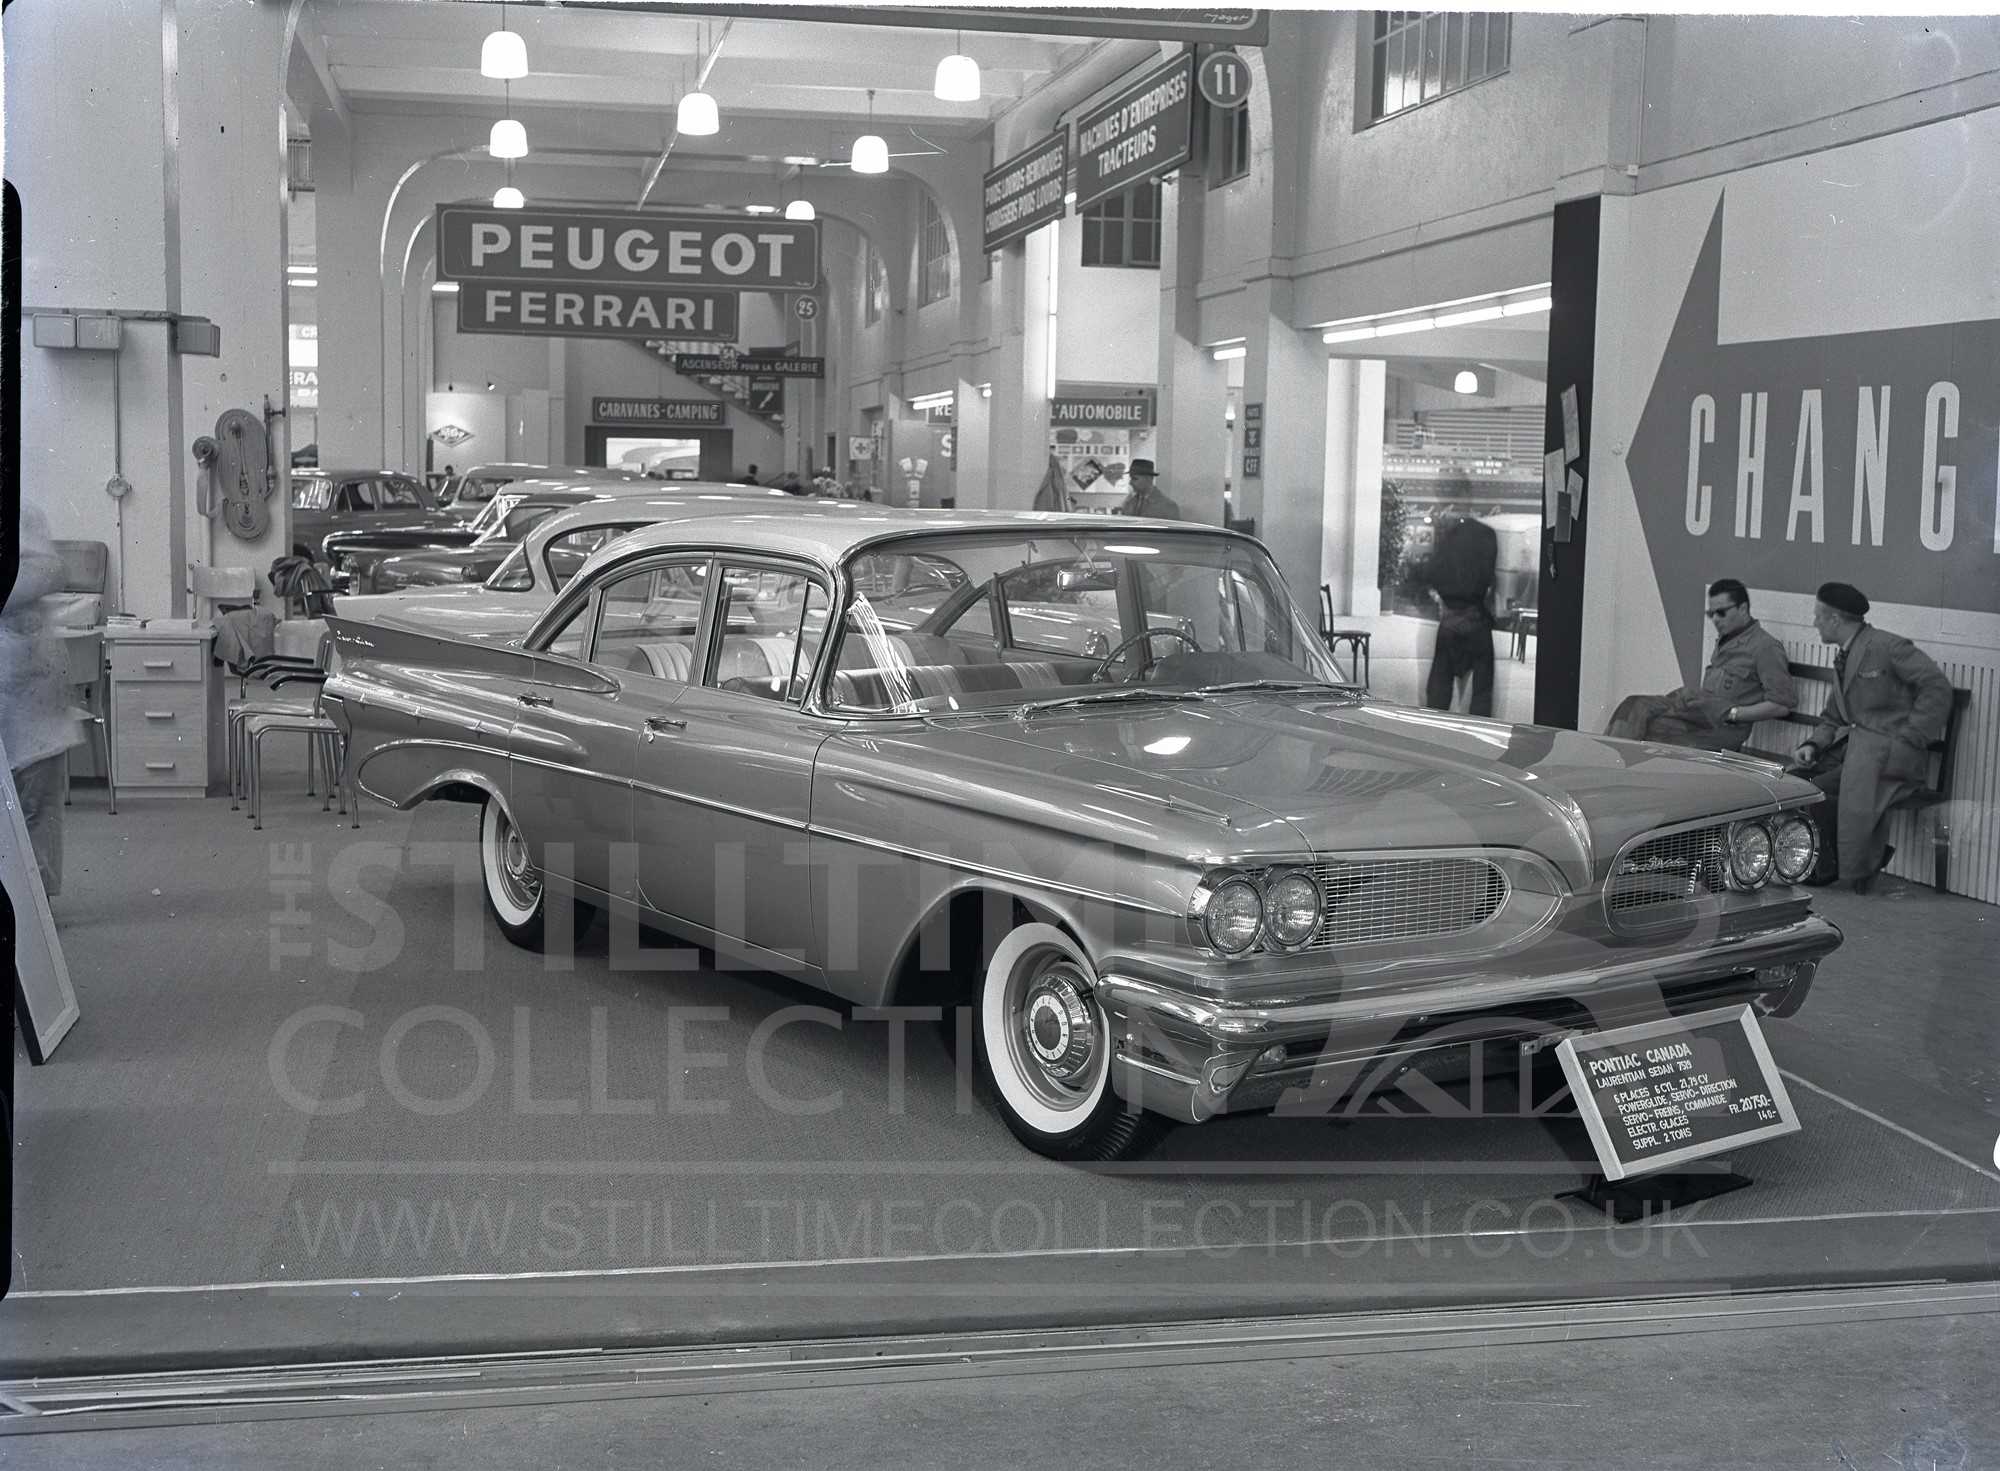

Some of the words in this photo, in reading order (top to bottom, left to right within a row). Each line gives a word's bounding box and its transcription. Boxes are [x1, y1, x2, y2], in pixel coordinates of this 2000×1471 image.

[1213, 63, 1237, 96] 11
[1080, 112, 1120, 156] MACHINES
[1098, 125, 1157, 178] TRACTEURS
[471, 222, 795, 278] PEUGEOT
[485, 289, 713, 331] FERRARI
[798, 301, 813, 316] 25
[774, 362, 818, 373] GALERIE
[599, 402, 718, 420] CARAVANES-CAMPING
[1050, 404, 1142, 420] L'AUTOMOBILE
[1685, 381, 2000, 554] CHANG
[1589, 1053, 1641, 1075] PONTIAC
[1646, 1042, 1692, 1063] CANADA
[1595, 1069, 1647, 1089] LAURENTIAN
[1649, 1063, 1675, 1078] SEDAN
[1613, 1094, 1620, 1103] 6
[1619, 1087, 1650, 1103] PLACES
[1655, 1084, 1661, 1094] 6
[1660, 1081, 1677, 1093] CYL.
[1698, 1074, 1709, 1085] CV
[1618, 1093, 1672, 1115] POWERGLIDE,
[1684, 1094, 1728, 1112] COMMANDE
[1627, 1122, 1659, 1138] ELECTR.
[1659, 1114, 1689, 1131] GLACES
[1632, 1135, 1661, 1150] SUPPL.
[1663, 1133, 1671, 1143] 2
[1670, 1127, 1693, 1141] TONS
